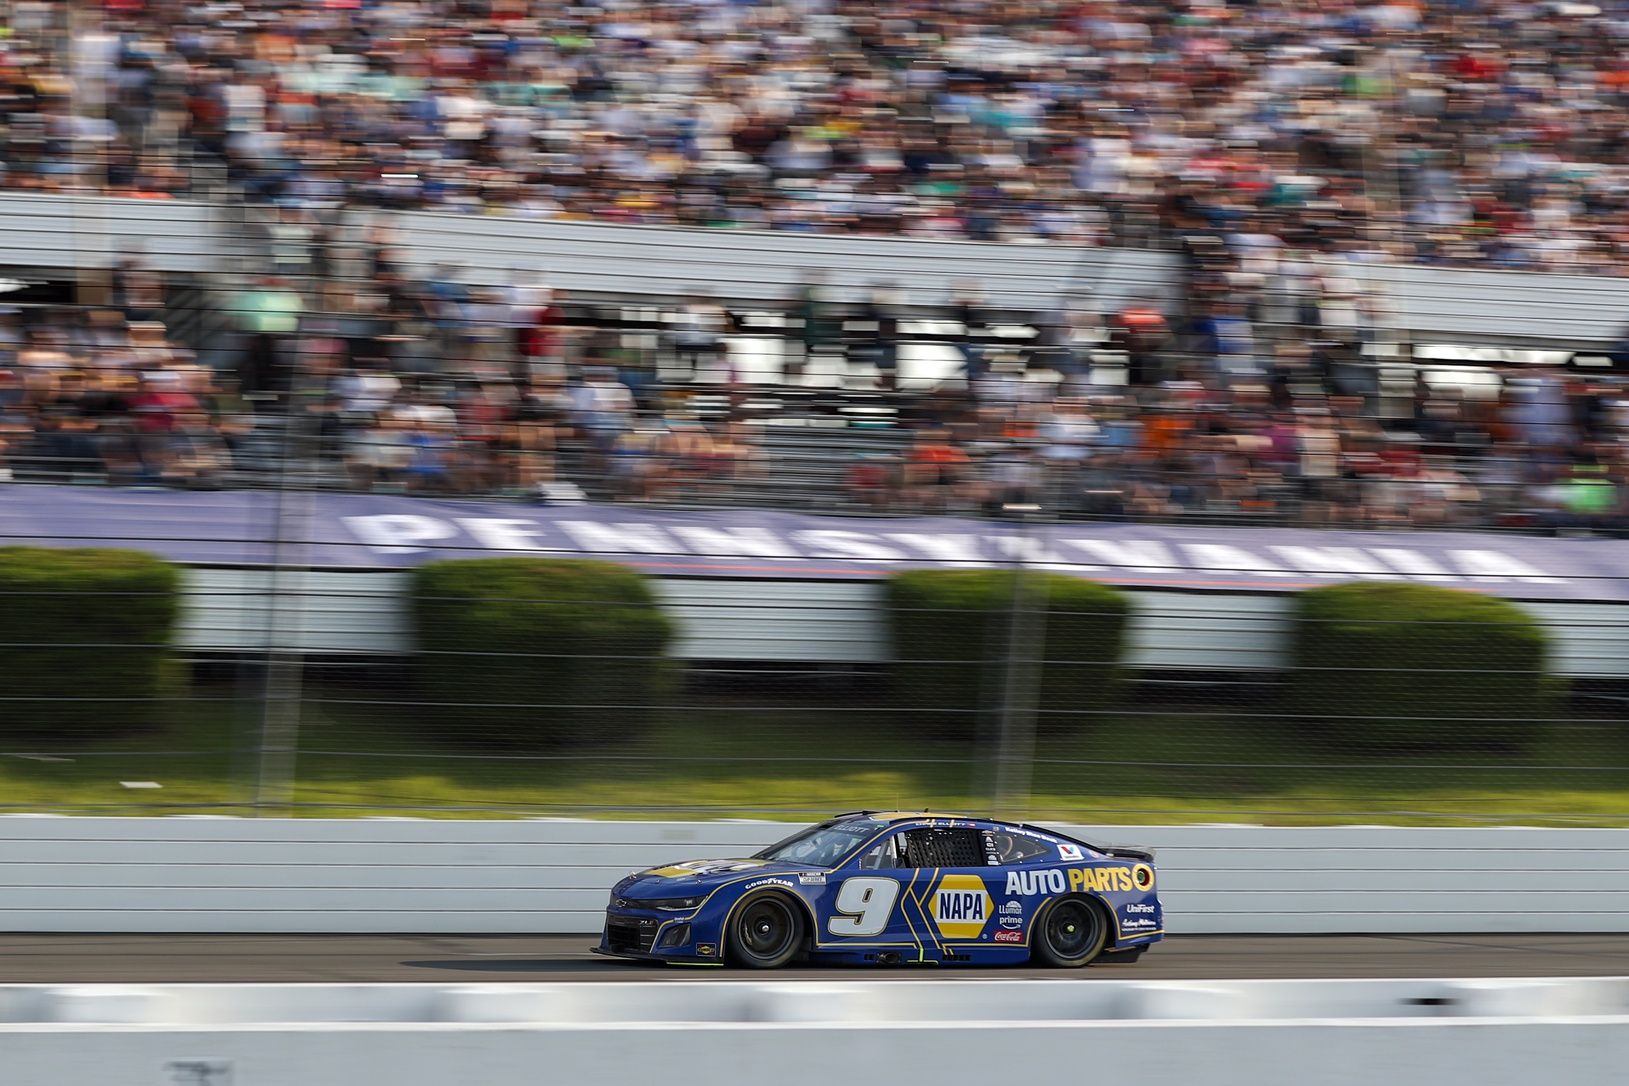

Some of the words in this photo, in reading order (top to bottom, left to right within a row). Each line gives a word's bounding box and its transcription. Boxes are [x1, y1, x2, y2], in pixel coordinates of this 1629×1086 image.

[744, 877, 794, 890] GOODYEAR
[1005, 868, 1066, 896] AUTO
[1068, 866, 1133, 892] PARTS
[828, 876, 900, 937] 9
[939, 893, 983, 920] NAPA
[1126, 903, 1155, 913] UniFirst
[999, 915, 1023, 925] prime
